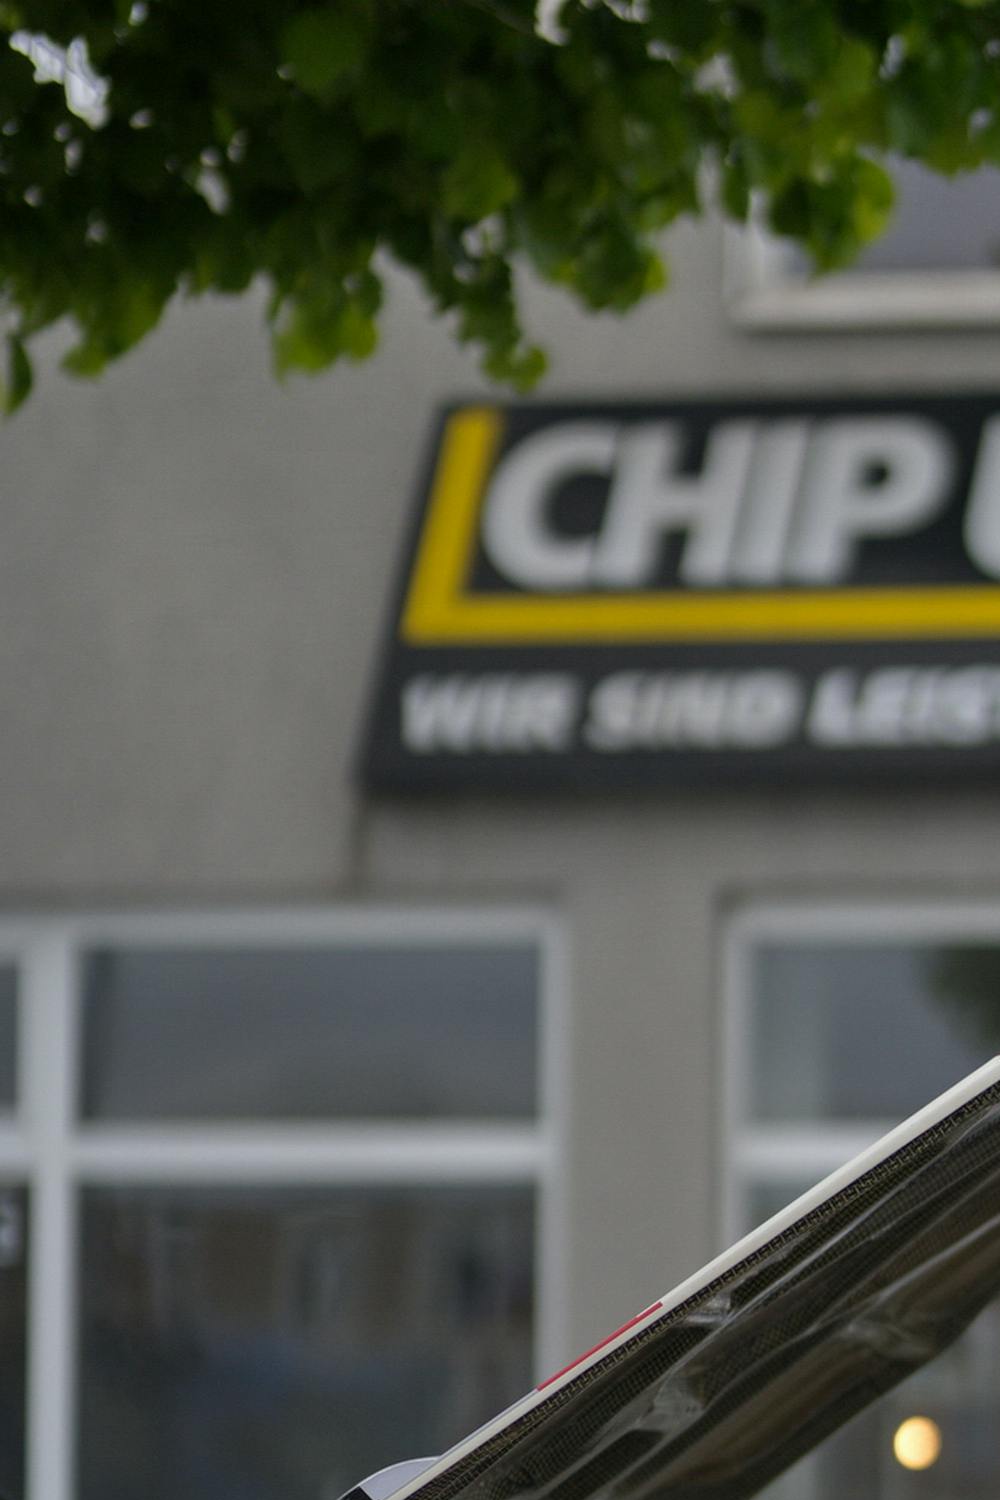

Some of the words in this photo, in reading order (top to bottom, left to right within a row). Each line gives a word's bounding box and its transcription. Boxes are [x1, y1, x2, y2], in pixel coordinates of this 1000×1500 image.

[480, 416, 952, 591] CHIP
[402, 671, 577, 753] WIR
[585, 668, 800, 751] SIND
